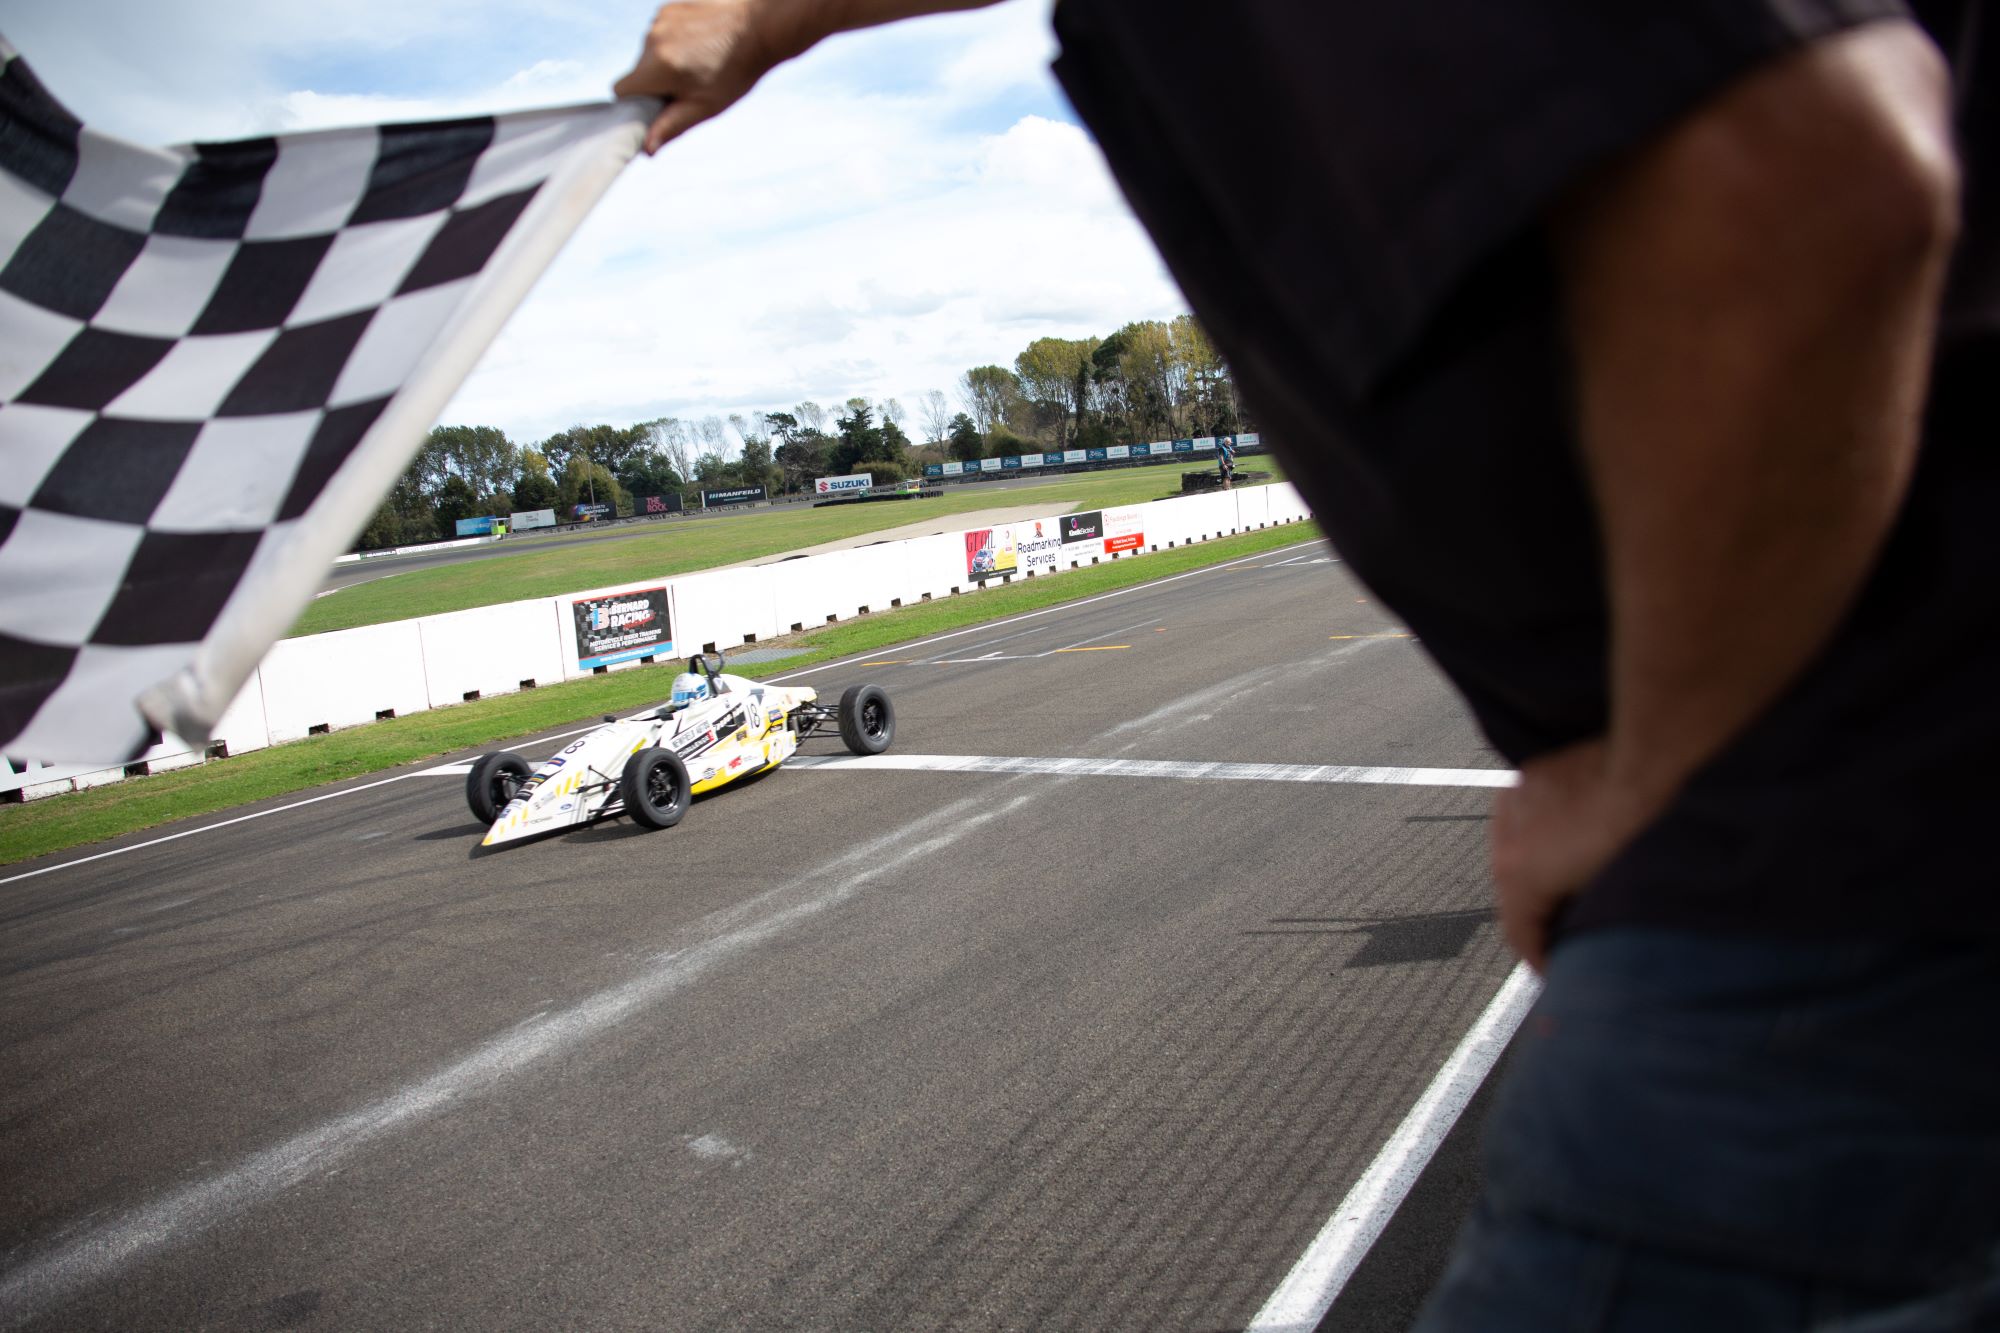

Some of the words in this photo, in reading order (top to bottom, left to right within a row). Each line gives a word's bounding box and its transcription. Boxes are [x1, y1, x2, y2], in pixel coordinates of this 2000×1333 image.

[830, 479, 870, 490] SUZUKI
[647, 496, 660, 504] THE
[718, 489, 761, 498] MANFEILD
[647, 503, 668, 513] ROCK
[966, 532, 979, 552] GT
[980, 529, 996, 551] OIL
[1017, 537, 1062, 554] Roadmarking
[1026, 552, 1056, 567] Services
[610, 599, 649, 615] BERNARD
[610, 610, 650, 628] RACING
[746, 703, 761, 729] 18
